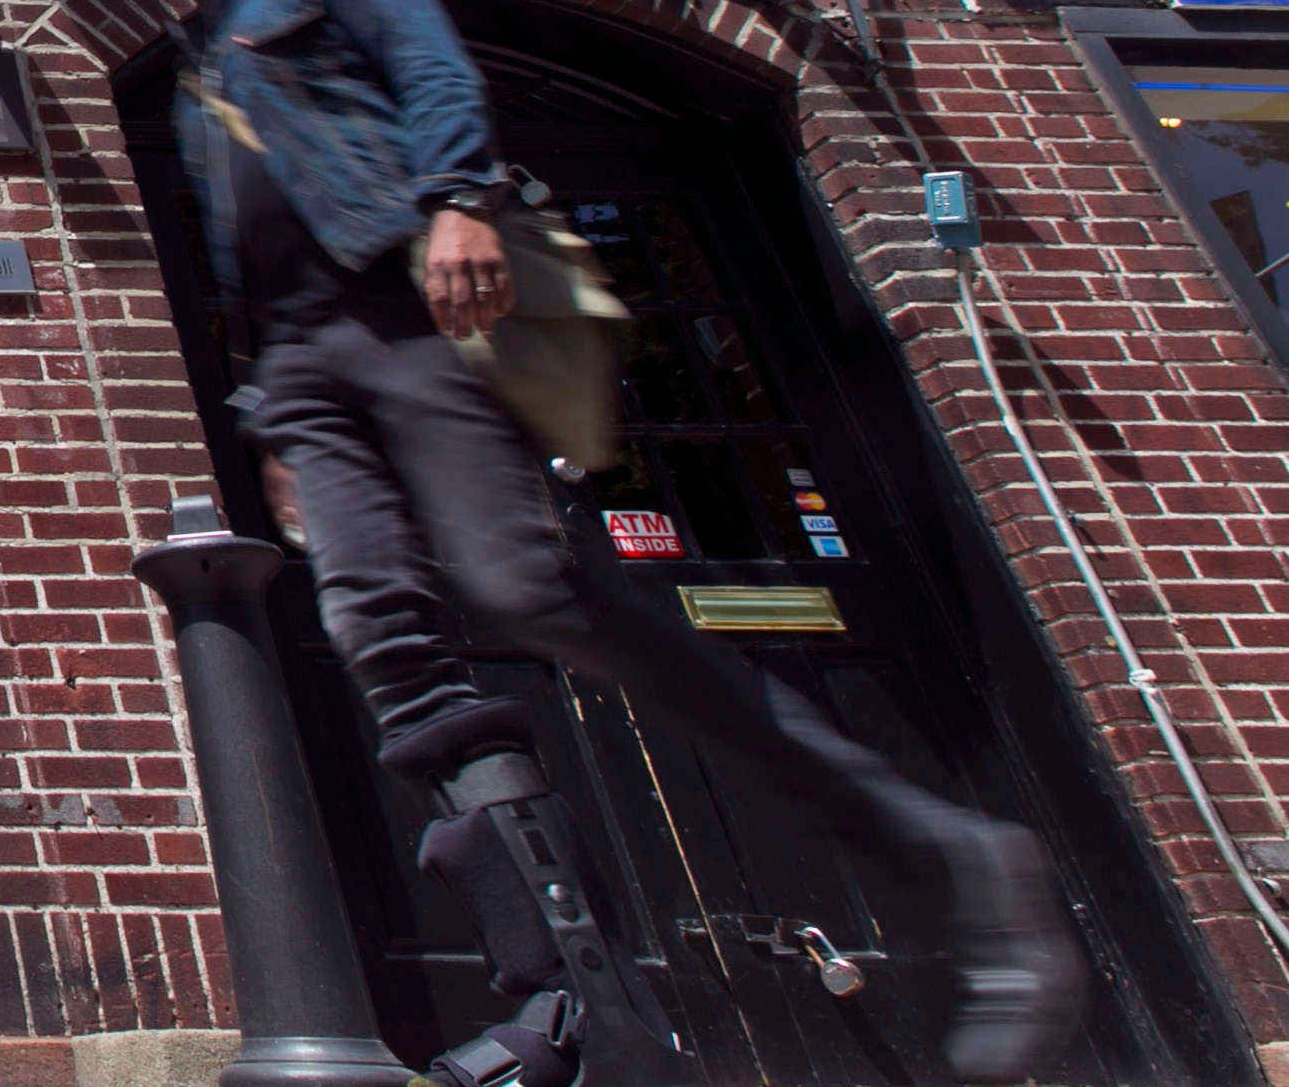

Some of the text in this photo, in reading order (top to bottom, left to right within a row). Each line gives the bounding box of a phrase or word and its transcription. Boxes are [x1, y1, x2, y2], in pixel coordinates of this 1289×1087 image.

[608, 513, 668, 534] ATM
[808, 518, 836, 529] VISA
[613, 537, 680, 553] INSIDE
